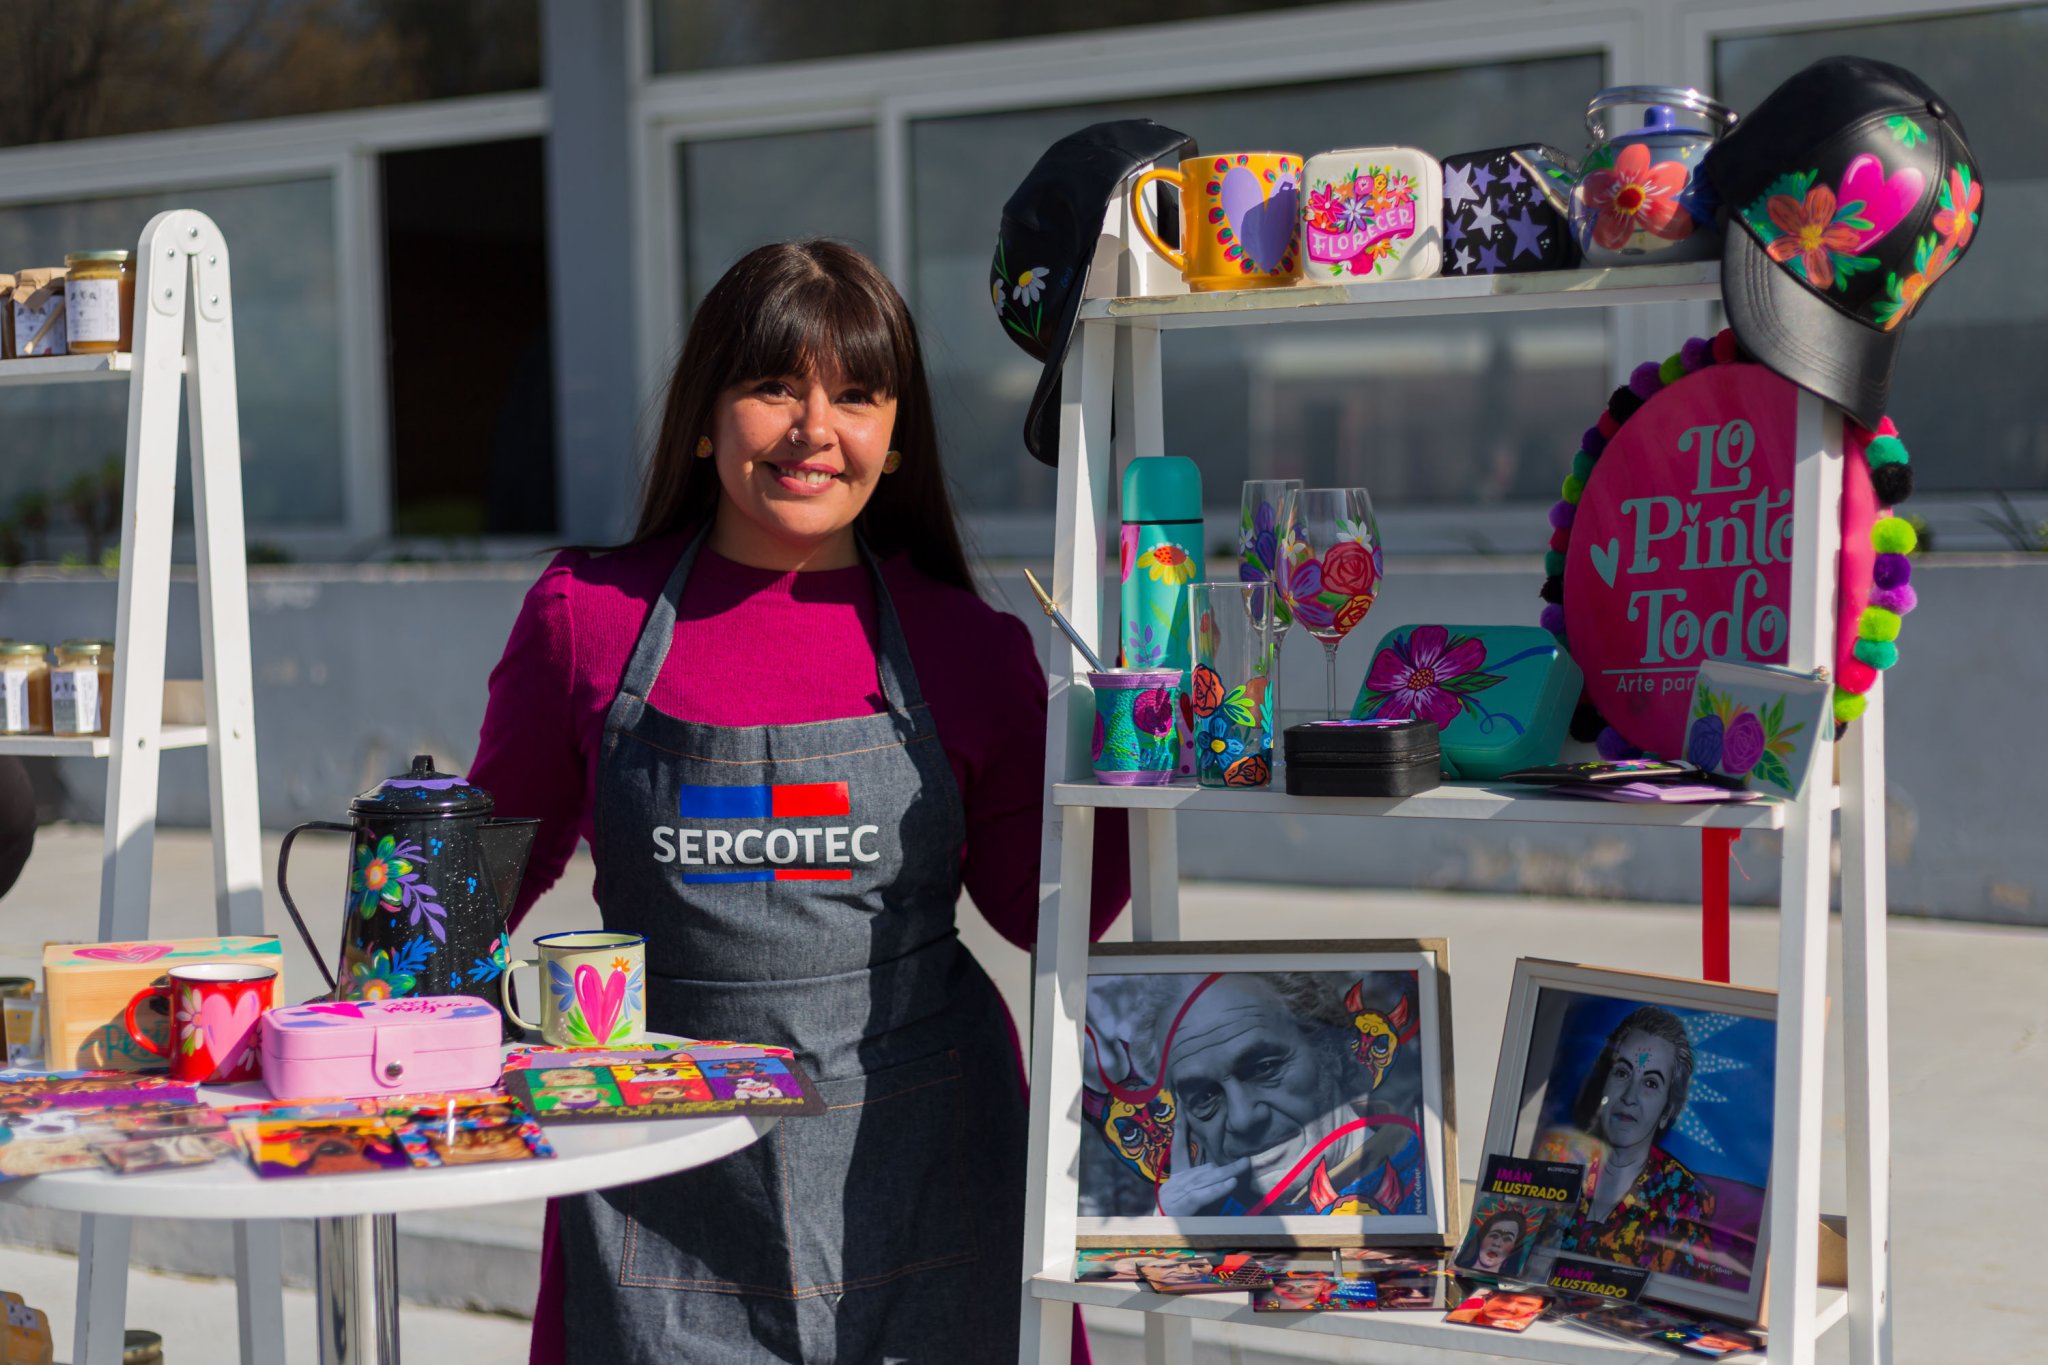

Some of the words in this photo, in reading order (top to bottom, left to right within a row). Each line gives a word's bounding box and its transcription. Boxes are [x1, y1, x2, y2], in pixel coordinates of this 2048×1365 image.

[1312, 208, 1413, 258] FLORECER
[1627, 569, 1787, 664] Todo
[1616, 674, 1655, 693] Arte
[1662, 676, 1696, 697] par
[652, 824, 880, 865] SERCOTEC
[1496, 1167, 1534, 1184] IMÁN
[1492, 1180, 1568, 1201] ILUSTRADO
[1550, 1276, 1628, 1299] ILUSTRADO
